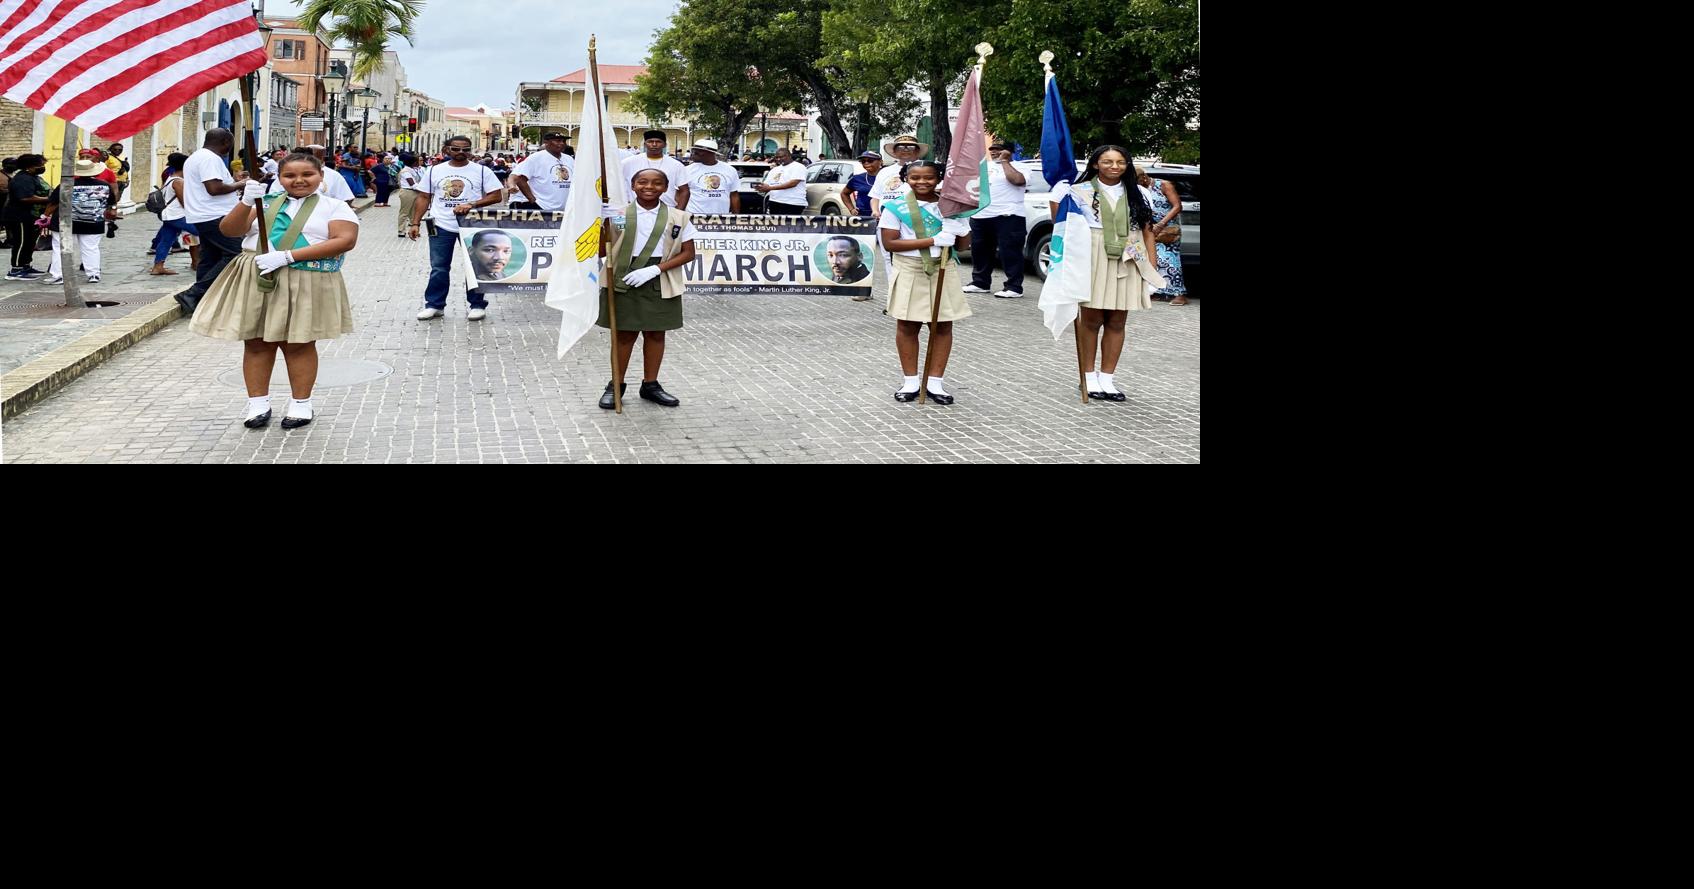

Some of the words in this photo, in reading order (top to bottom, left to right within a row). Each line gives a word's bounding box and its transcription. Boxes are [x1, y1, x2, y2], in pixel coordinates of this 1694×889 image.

[465, 209, 544, 221] ALPHA
[552, 210, 564, 221] P
[693, 213, 818, 229] RATERNITY,
[825, 215, 869, 227] INC.
[694, 239, 737, 251] THER
[740, 239, 781, 251] KING
[785, 240, 810, 251] JR.
[530, 252, 553, 280] P
[684, 254, 811, 282] MARCH
